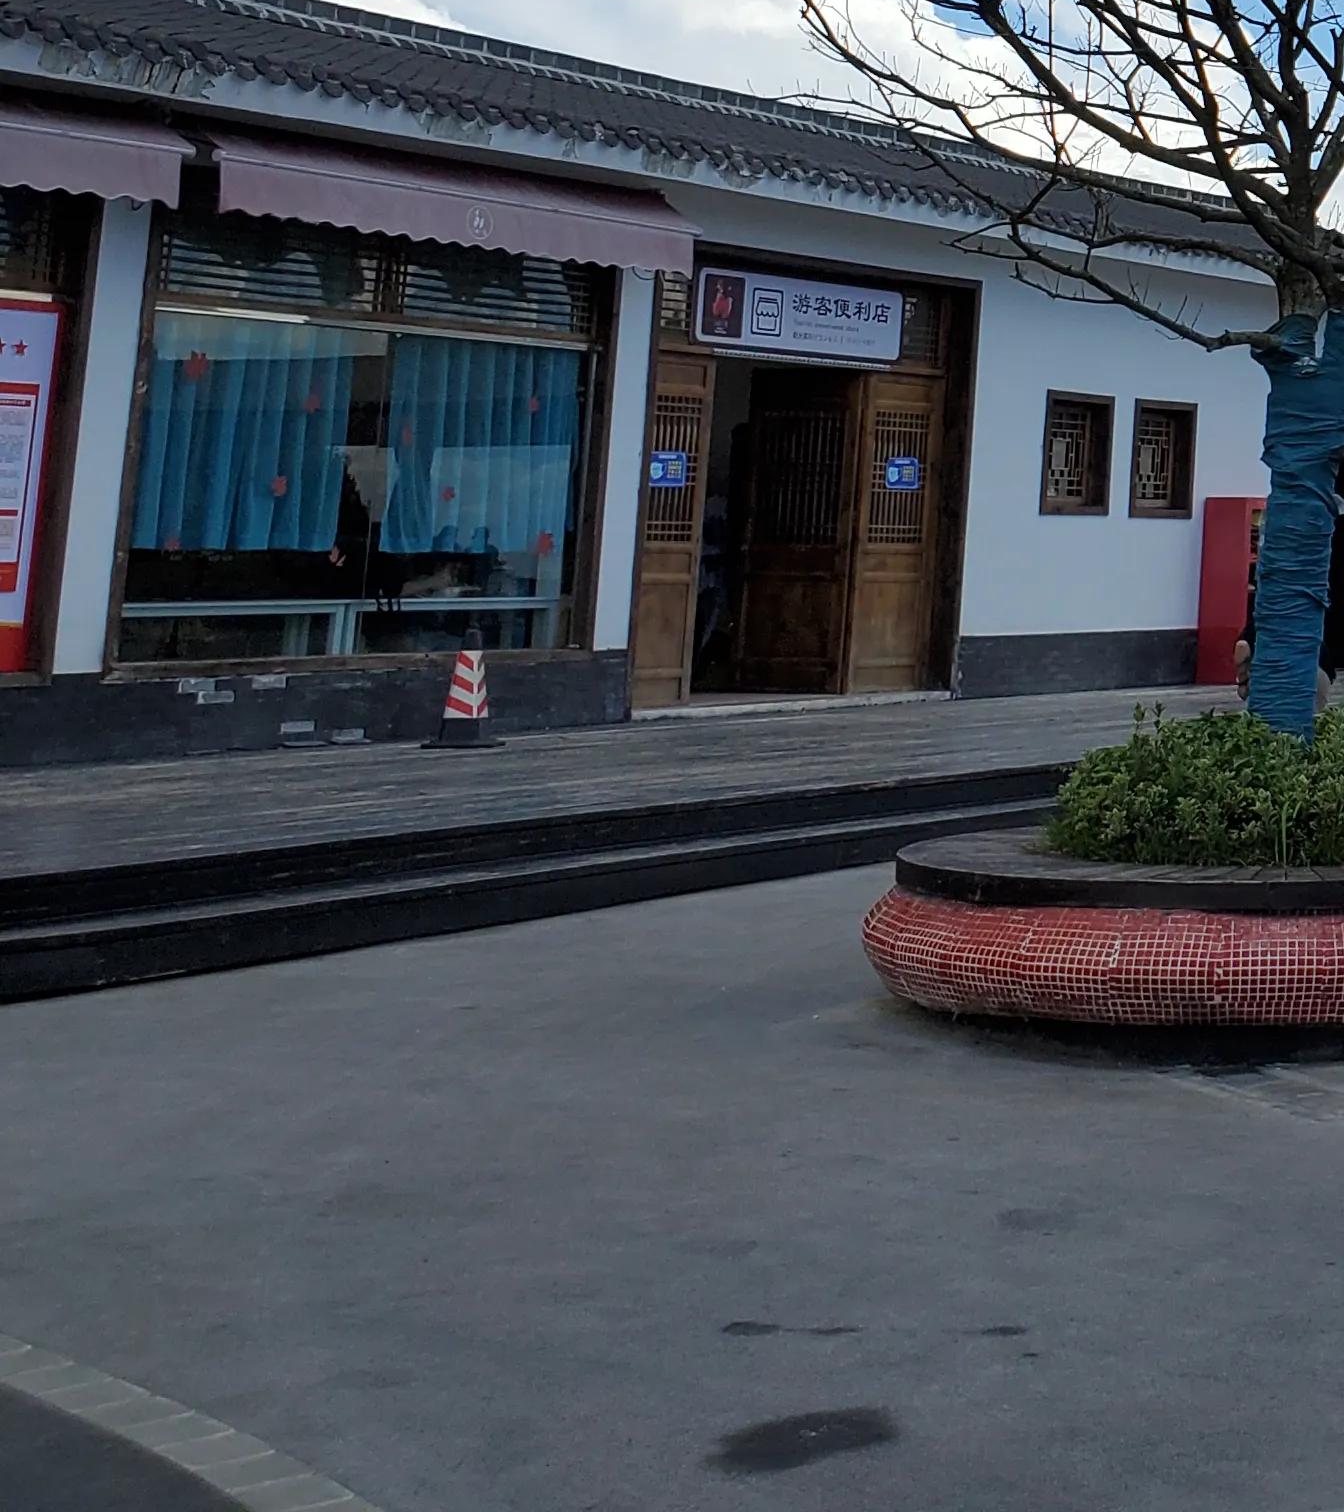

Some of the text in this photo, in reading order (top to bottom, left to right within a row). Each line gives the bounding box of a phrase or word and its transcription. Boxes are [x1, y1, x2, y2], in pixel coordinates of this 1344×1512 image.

[792, 293, 892, 324] 游客便利店
